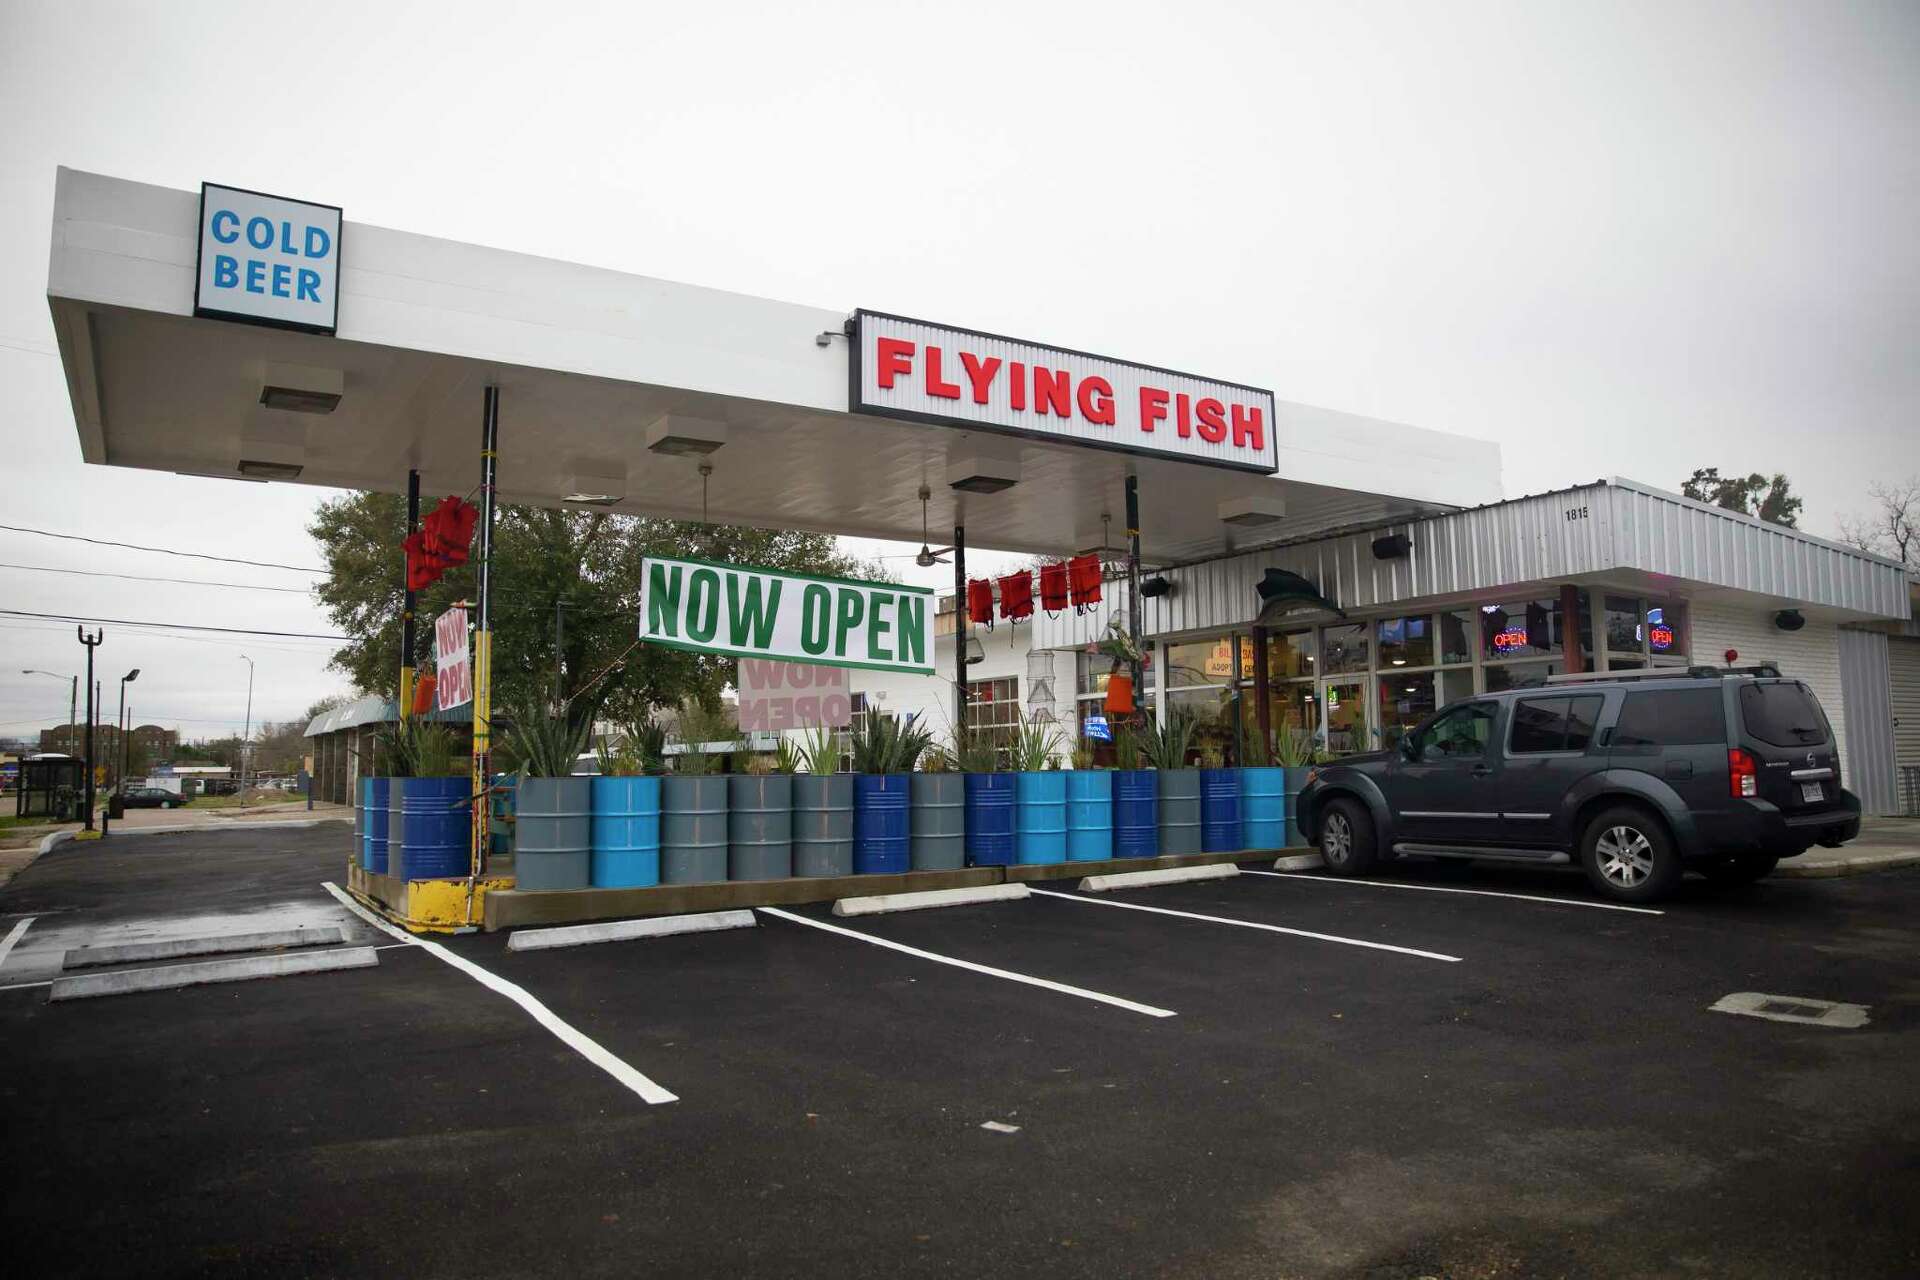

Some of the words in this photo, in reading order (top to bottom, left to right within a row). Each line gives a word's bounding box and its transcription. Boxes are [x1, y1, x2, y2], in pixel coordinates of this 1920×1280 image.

[211, 209, 331, 259] COLD
[214, 254, 322, 303] BEER
[877, 336, 1116, 426] FLYING
[1139, 386, 1264, 450] FISH
[1566, 506, 1588, 521] 1815
[649, 563, 783, 649] NOW
[801, 583, 925, 664] OPEN
[1652, 629, 1672, 644] OPEN
[1495, 631, 1527, 646] OPEN
